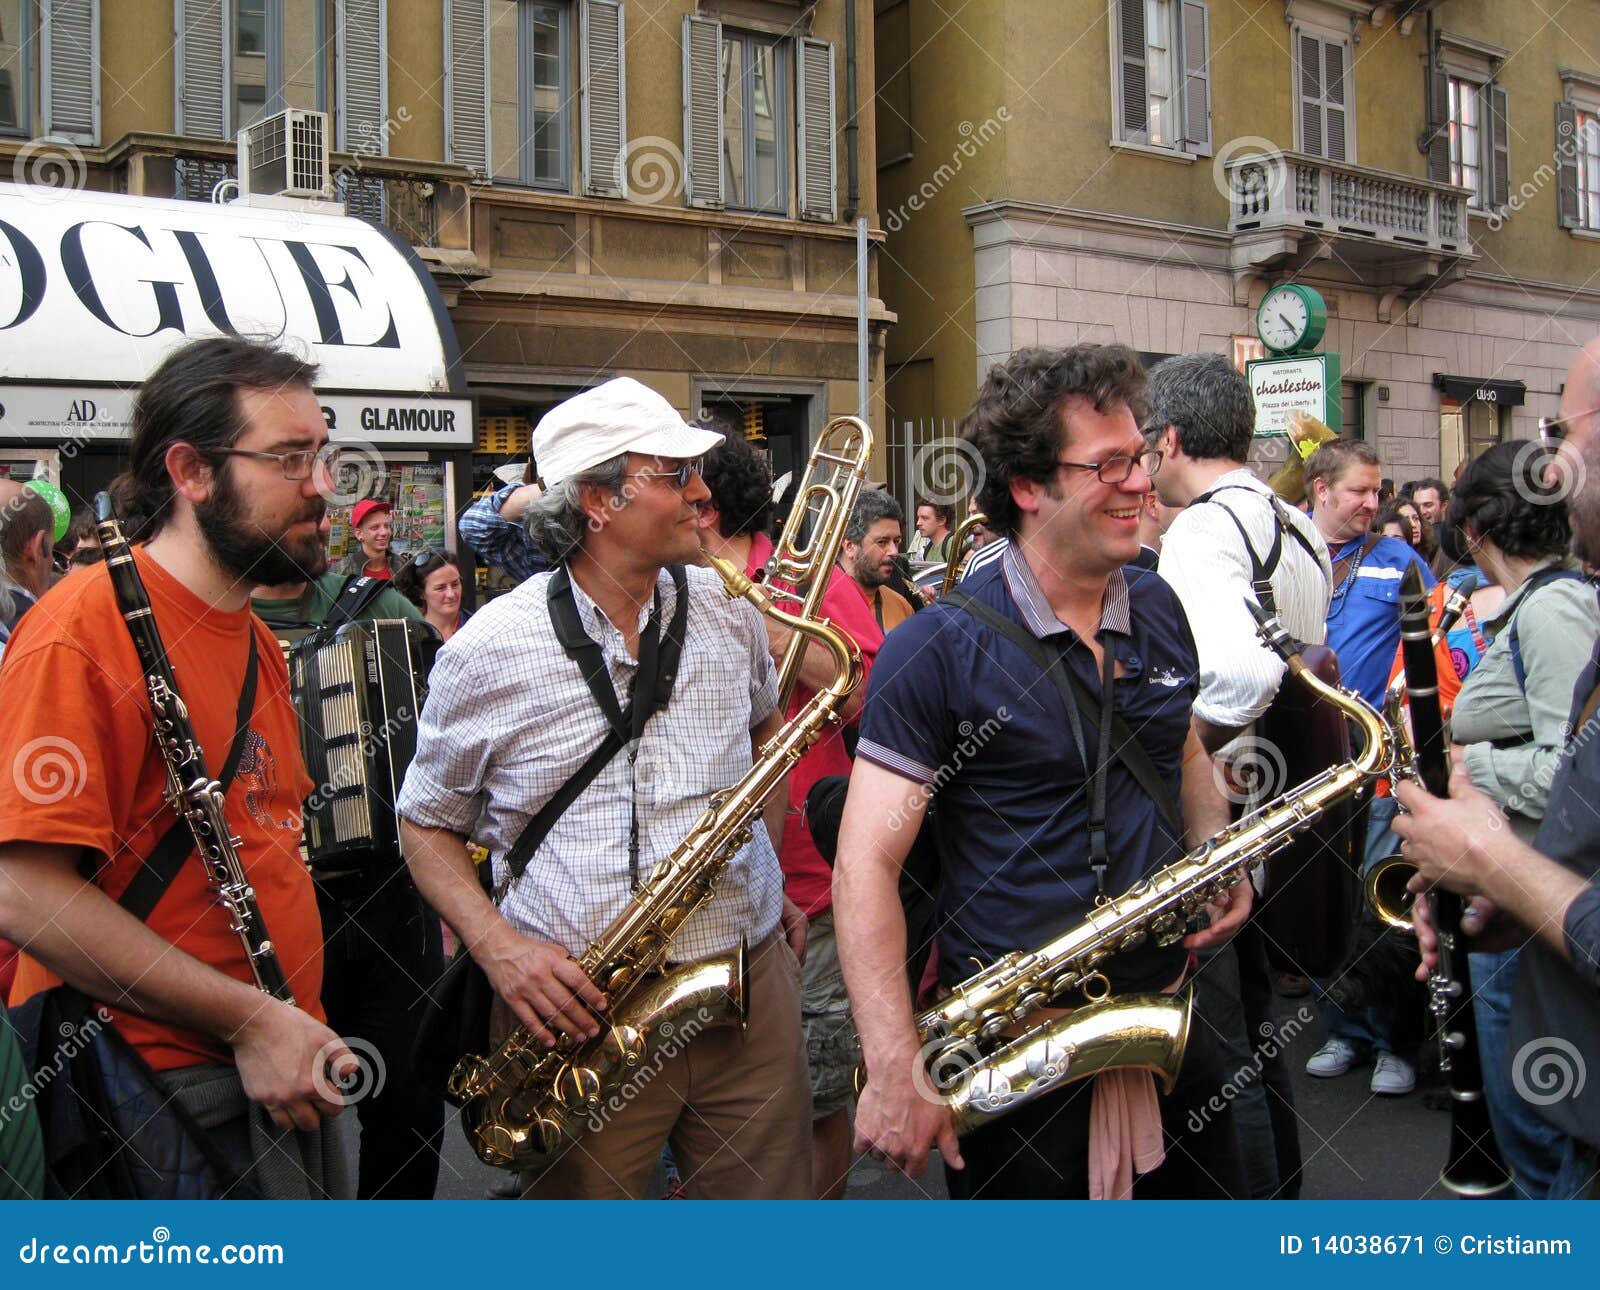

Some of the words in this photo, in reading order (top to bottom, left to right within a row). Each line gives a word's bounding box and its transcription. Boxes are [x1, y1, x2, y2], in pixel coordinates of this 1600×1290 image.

[1256, 378, 1322, 396] charleston
[67, 399, 97, 421] AD
[320, 406, 337, 430] Q
[360, 407, 456, 432] GLAMOUR
